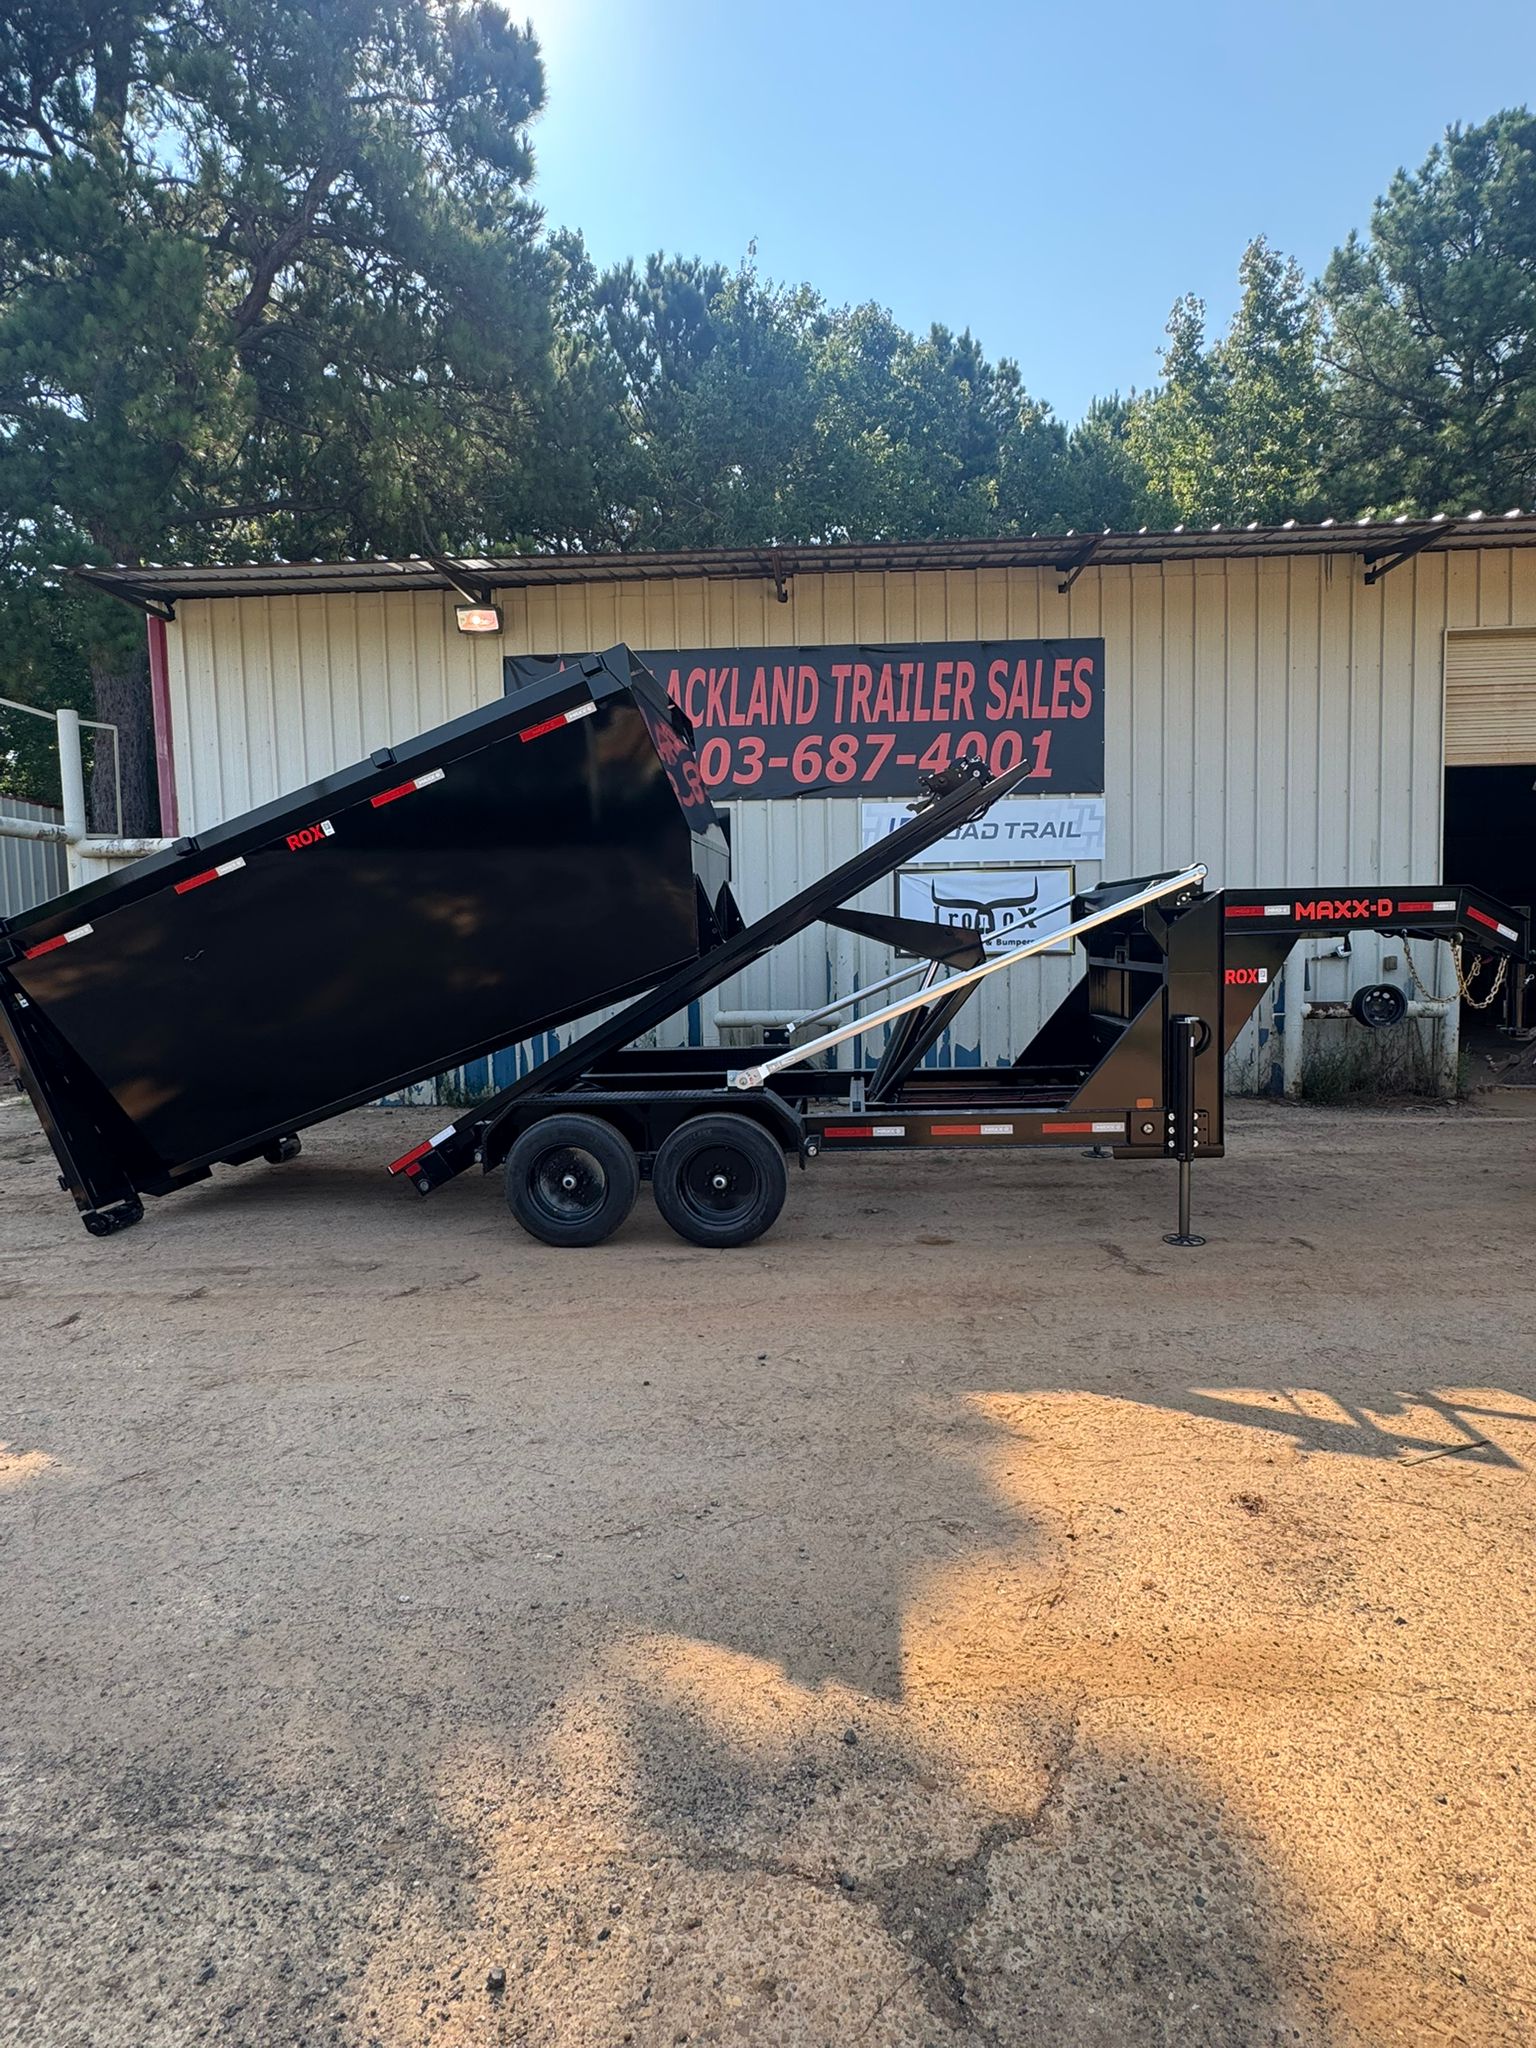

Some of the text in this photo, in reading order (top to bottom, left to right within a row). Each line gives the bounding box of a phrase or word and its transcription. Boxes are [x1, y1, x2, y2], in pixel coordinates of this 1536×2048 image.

[831, 661, 976, 724] TRAILER
[985, 657, 1095, 721] SALES
[698, 729, 1053, 787] 03-687-4001
[286, 824, 324, 851] ROX
[1005, 822, 1082, 839] TRAIL
[1294, 898, 1393, 921] MAXX-D
[1225, 968, 1258, 984] ROX
